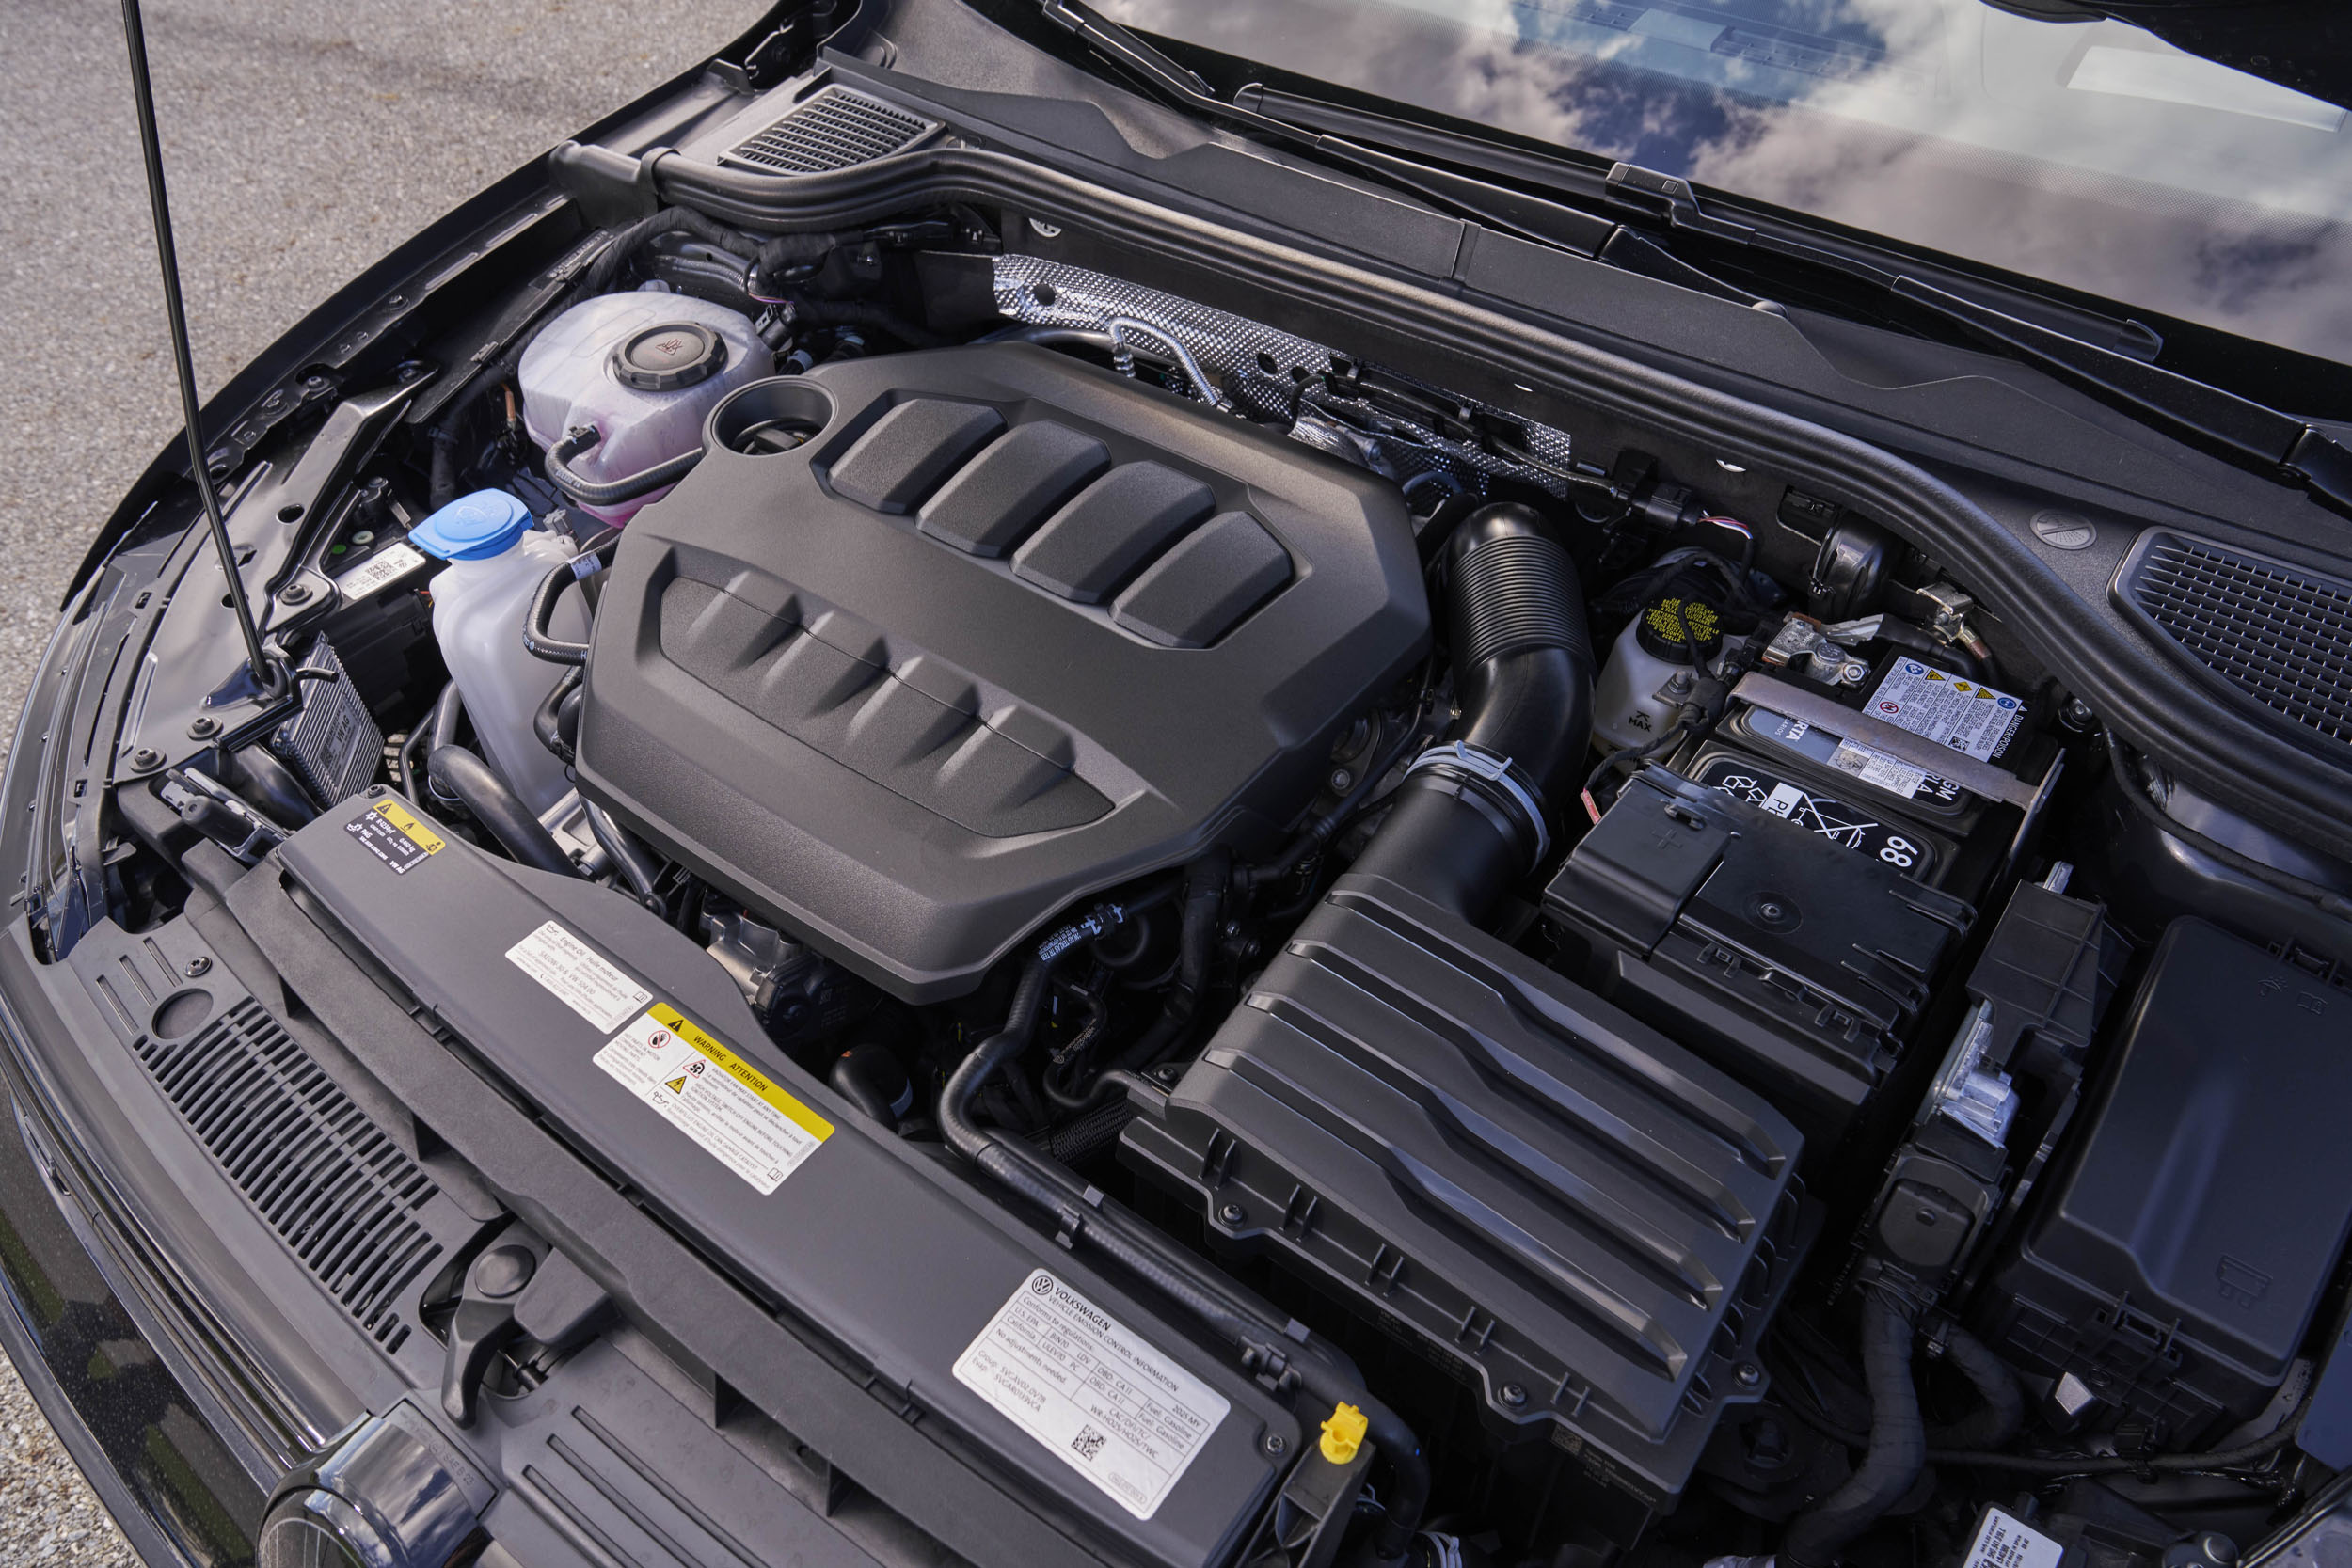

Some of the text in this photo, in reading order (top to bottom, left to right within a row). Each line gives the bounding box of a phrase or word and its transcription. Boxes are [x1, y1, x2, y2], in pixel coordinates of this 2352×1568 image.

[1629, 717, 1652, 732] MAX
[1786, 721, 1808, 742] RTA
[1934, 780, 1960, 801] GM
[1880, 836, 1918, 868] 68
[558, 936, 619, 981] Engine Oil Huile moteur
[692, 1035, 768, 1092] WARNING ATTENTION
[711, 1067, 731, 1083] RADIATOR
[738, 1086, 748, 1095] MAY
[745, 1092, 758, 1102] START
[1022, 1296, 1053, 1321] Conforms
[1050, 1316, 1060, 1325] to
[1053, 1287, 1112, 1331] VOLKSWAGEN
[995, 1328, 1007, 1338] No
[1004, 1335, 1043, 1367] adjustments
[1046, 1295, 1180, 1392] VEHICLE EMISSION CONTROL INFORMATION
[1041, 1341, 1066, 1361] ULEV70
[1068, 1361, 1079, 1371] PC
[1154, 1424, 1185, 1449] Gasoline
[1076, 1352, 1091, 1365] LDV
[1163, 1415, 1193, 1439] Gasoline
[1171, 1403, 1201, 1429] 2025 MY
